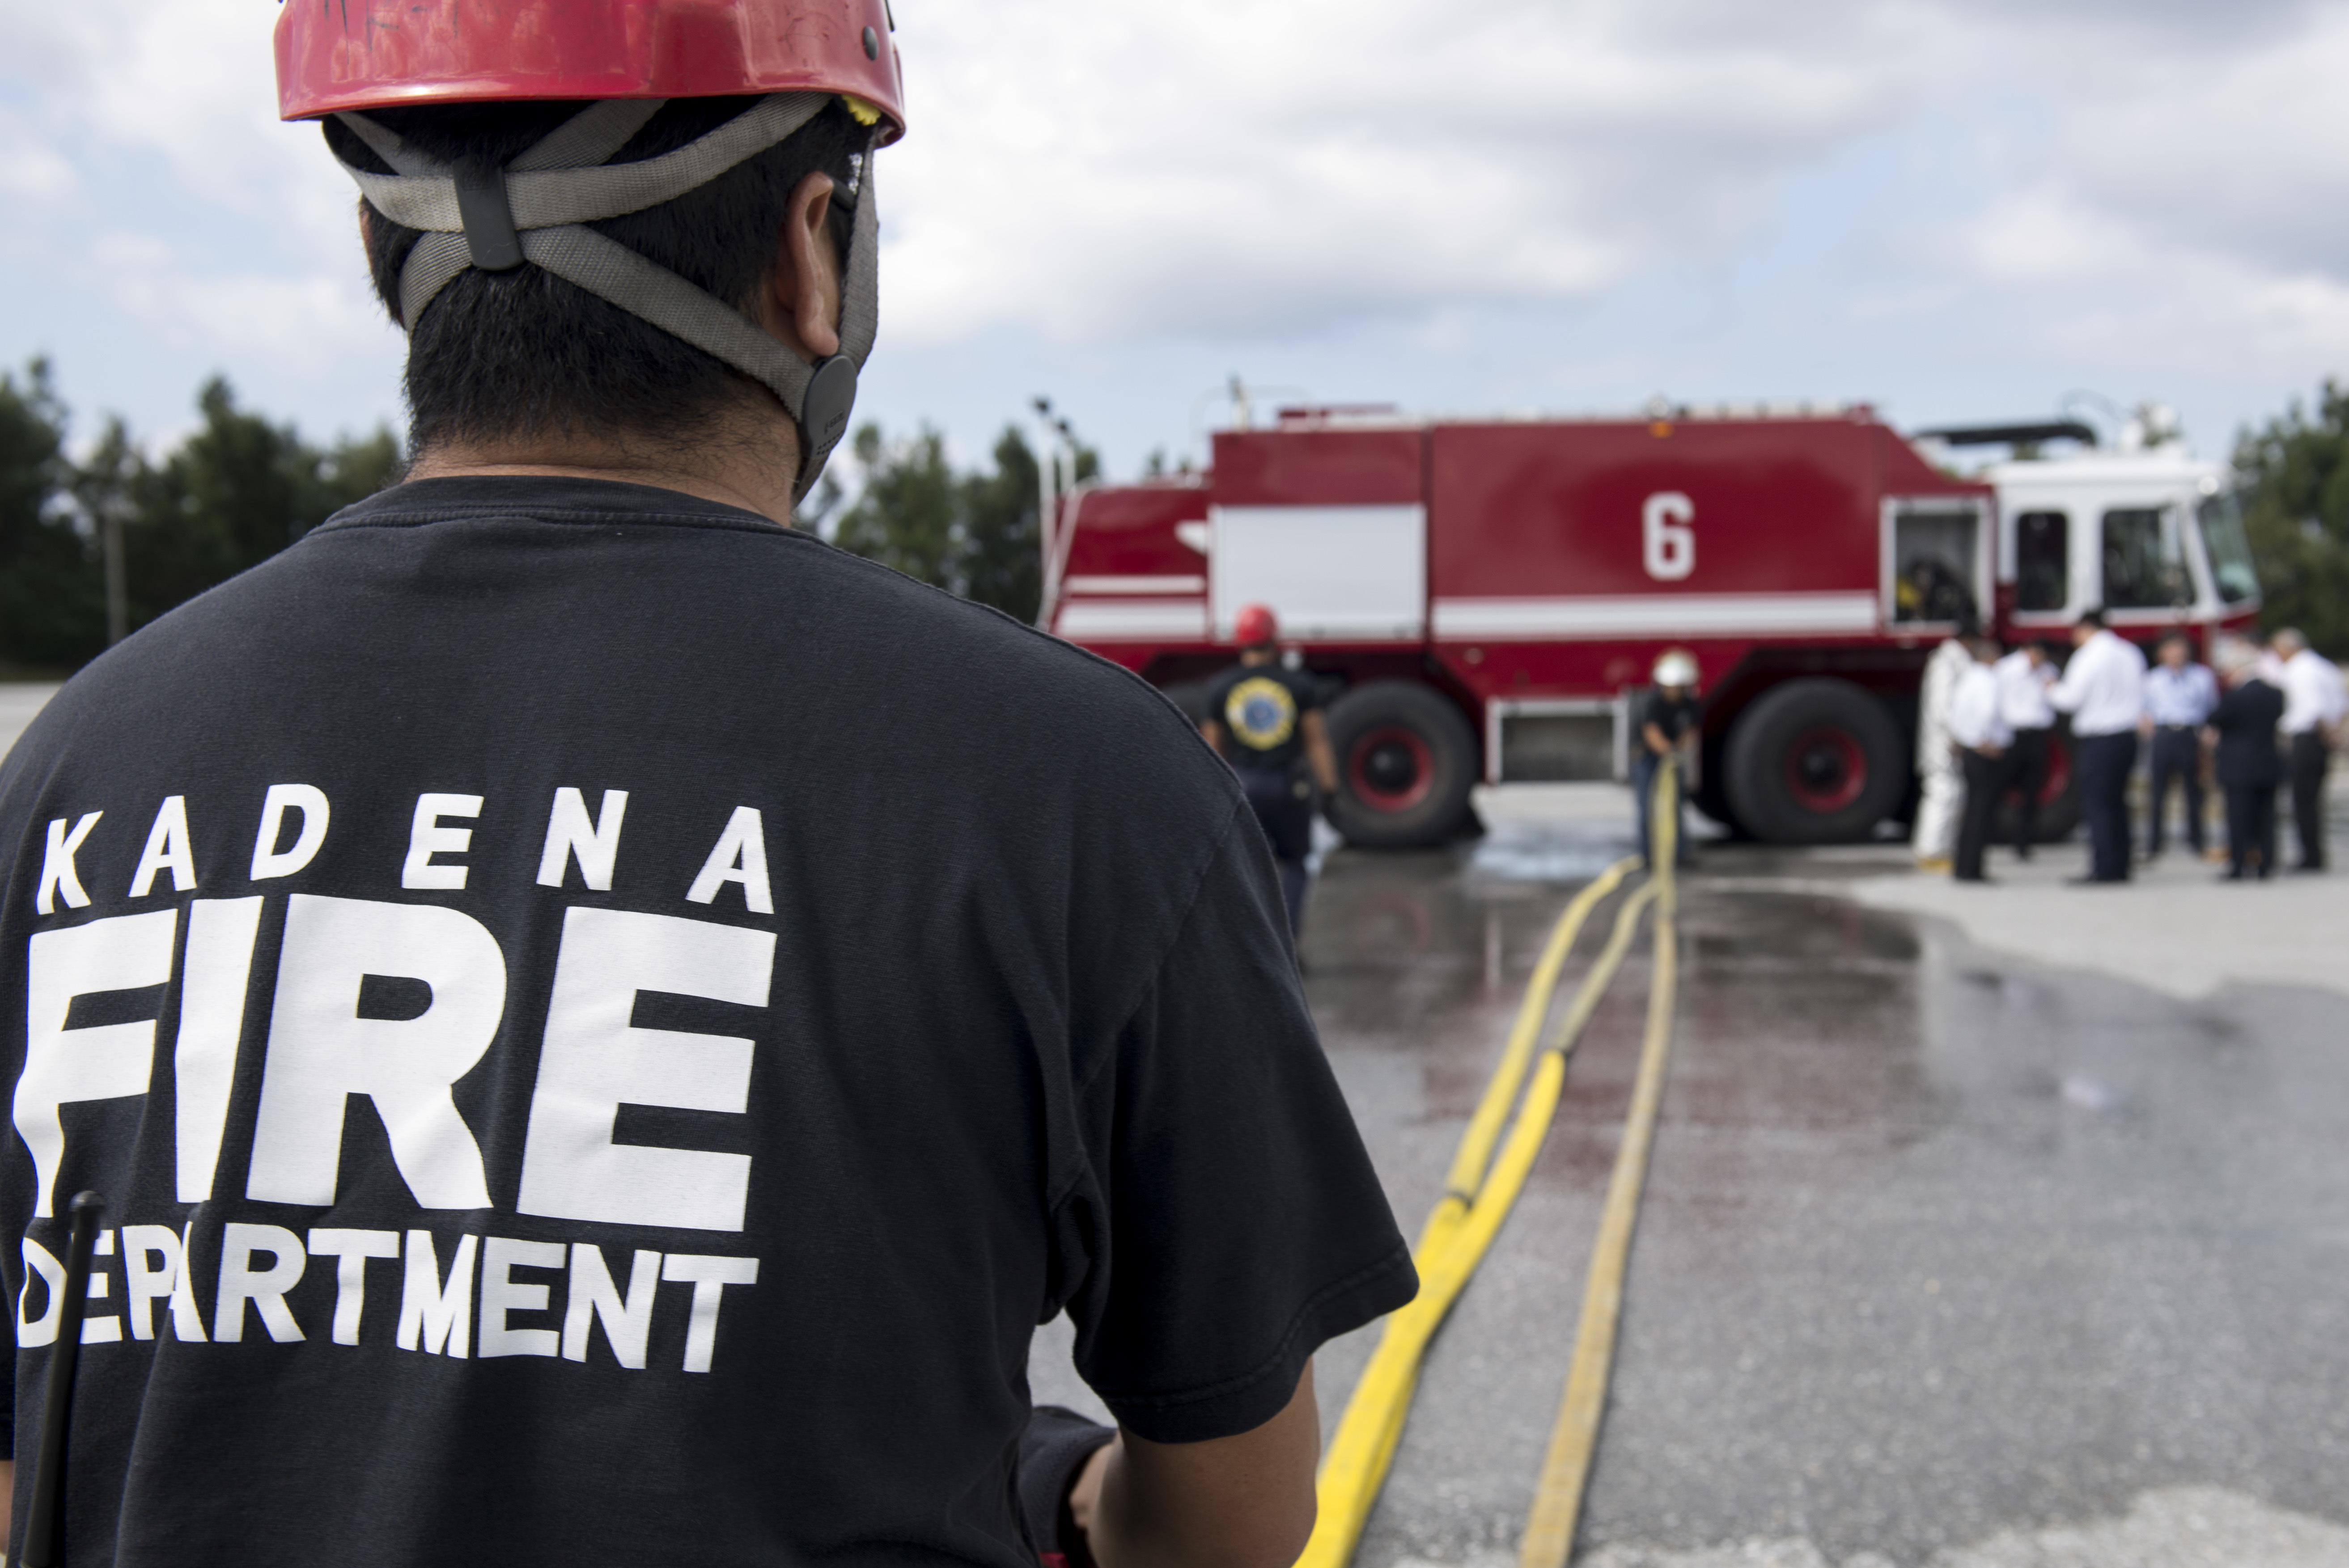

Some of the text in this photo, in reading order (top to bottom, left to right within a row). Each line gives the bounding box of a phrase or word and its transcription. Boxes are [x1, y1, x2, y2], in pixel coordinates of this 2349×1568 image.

[1642, 491, 1696, 581] 6
[37, 783, 774, 915] KADENA
[13, 893, 778, 1232] FIRE
[17, 1220, 759, 1373] DEPARTMENT
